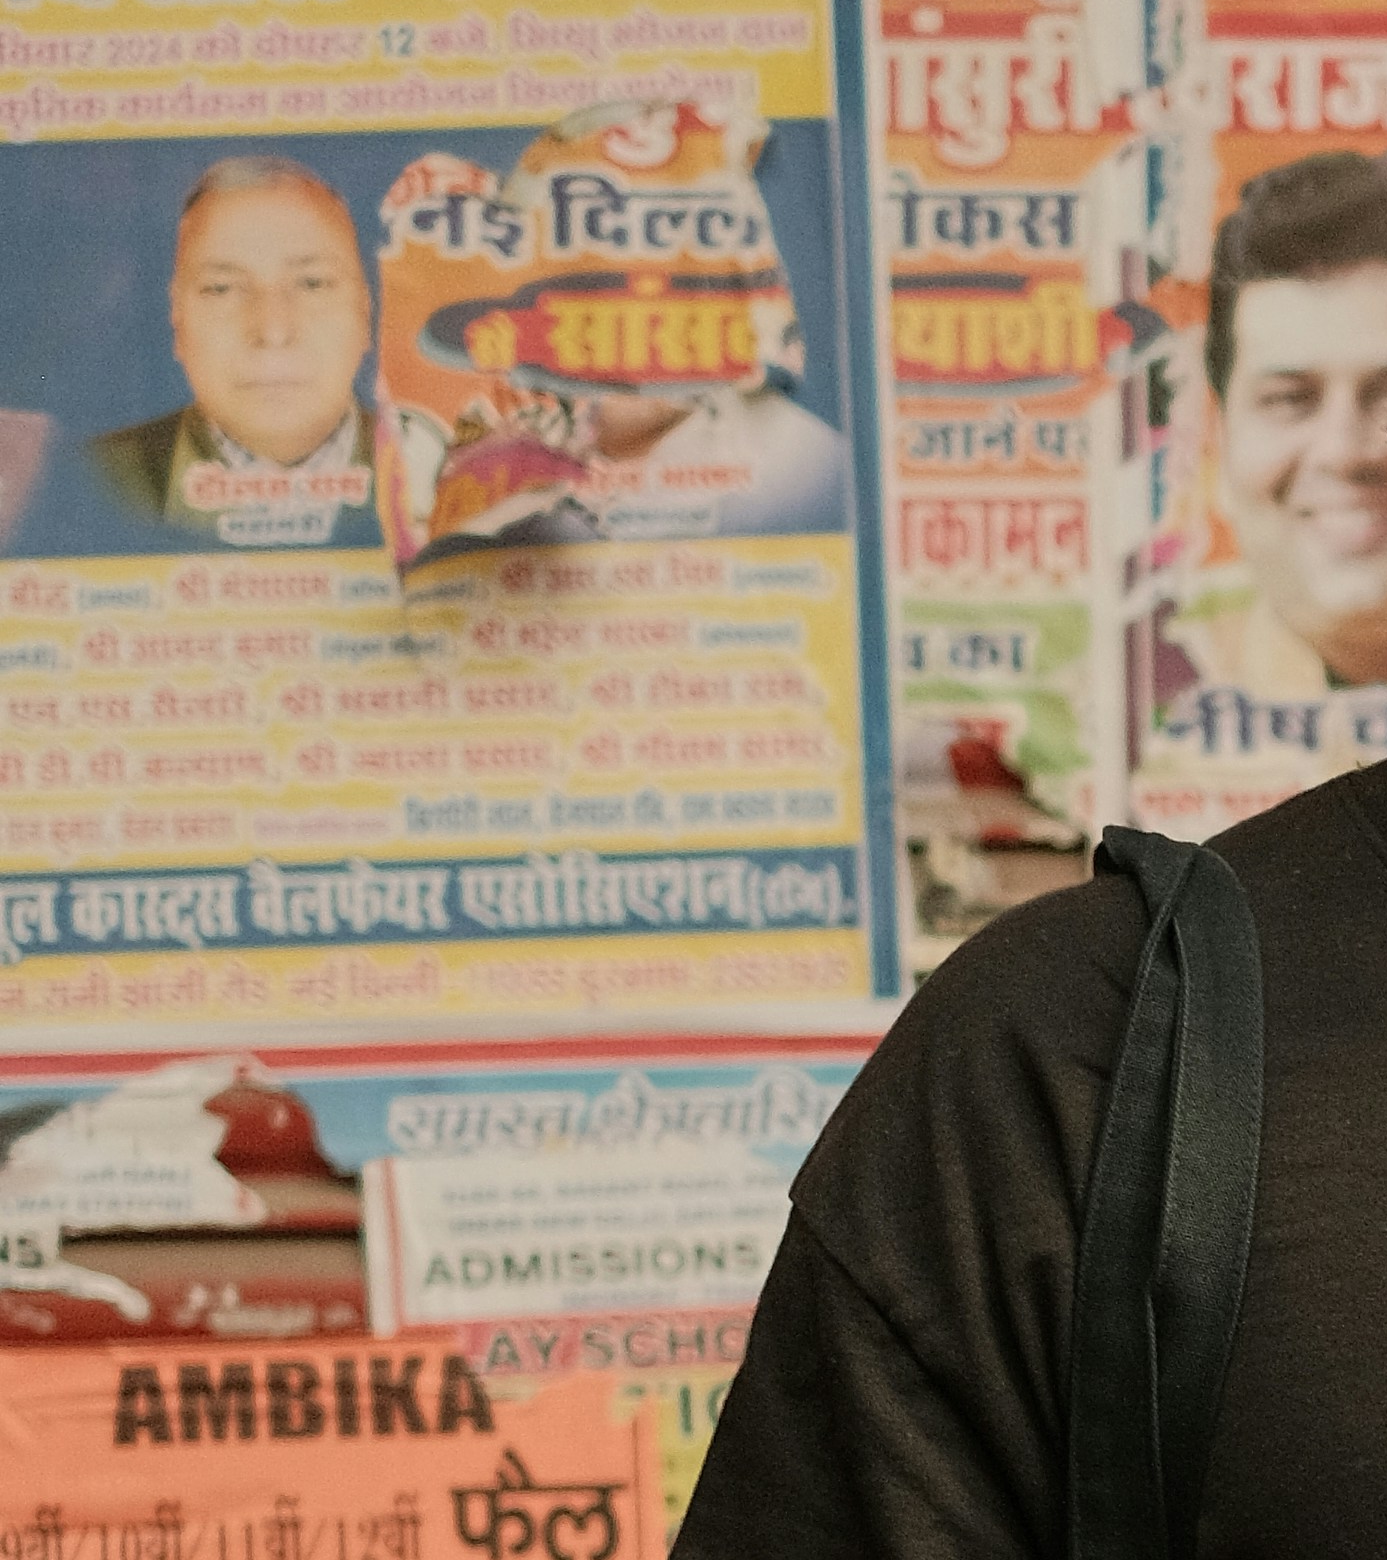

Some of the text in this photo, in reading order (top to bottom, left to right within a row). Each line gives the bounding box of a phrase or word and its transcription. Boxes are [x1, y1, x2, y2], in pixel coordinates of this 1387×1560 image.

[377, 26, 414, 59] 12
[424, 1242, 761, 1290] ADMISSIONS
[113, 1352, 497, 1446] AMBIKA
